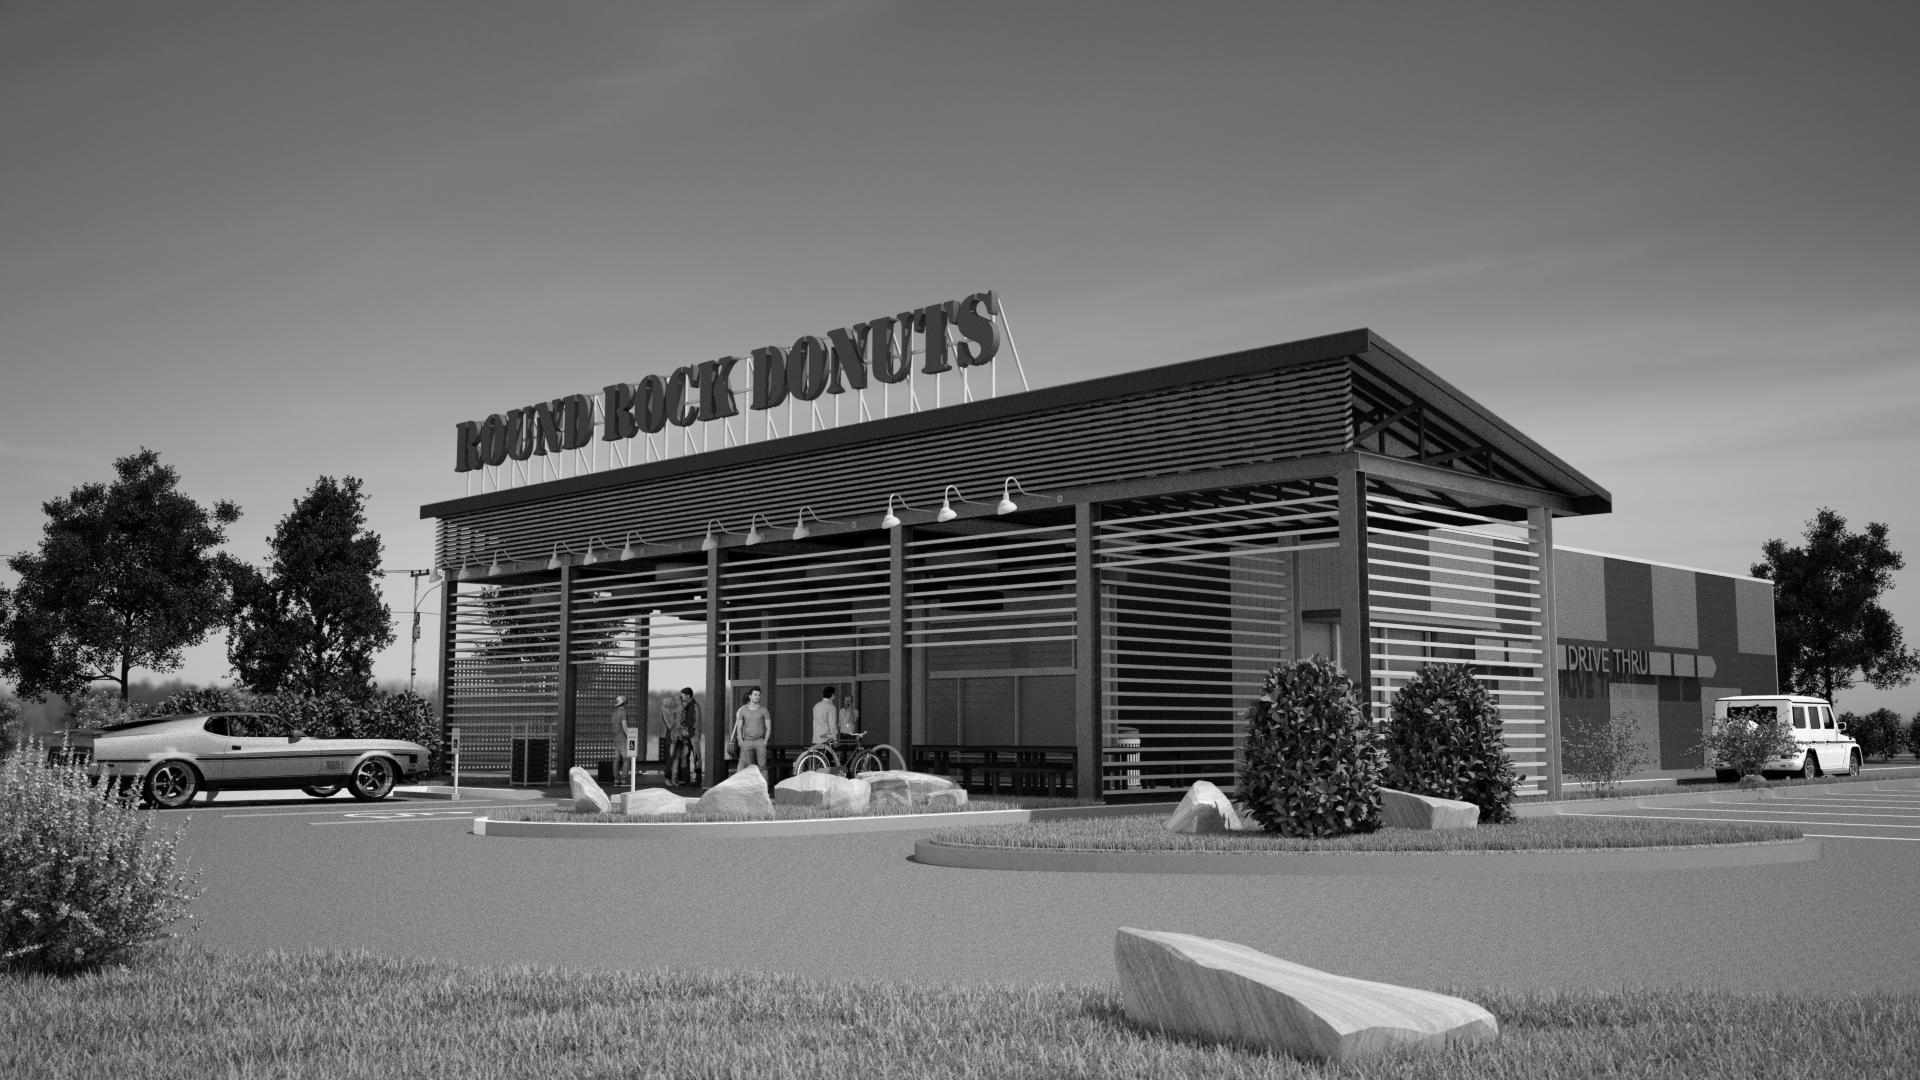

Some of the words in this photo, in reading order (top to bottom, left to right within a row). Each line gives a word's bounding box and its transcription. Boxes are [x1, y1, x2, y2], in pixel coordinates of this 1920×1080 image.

[455, 394, 595, 472] ROUND
[602, 356, 739, 442] ROCK
[750, 290, 1000, 411] DONUTS
[1568, 645, 1610, 673] DRIVE
[1613, 649, 1648, 675] THRU
